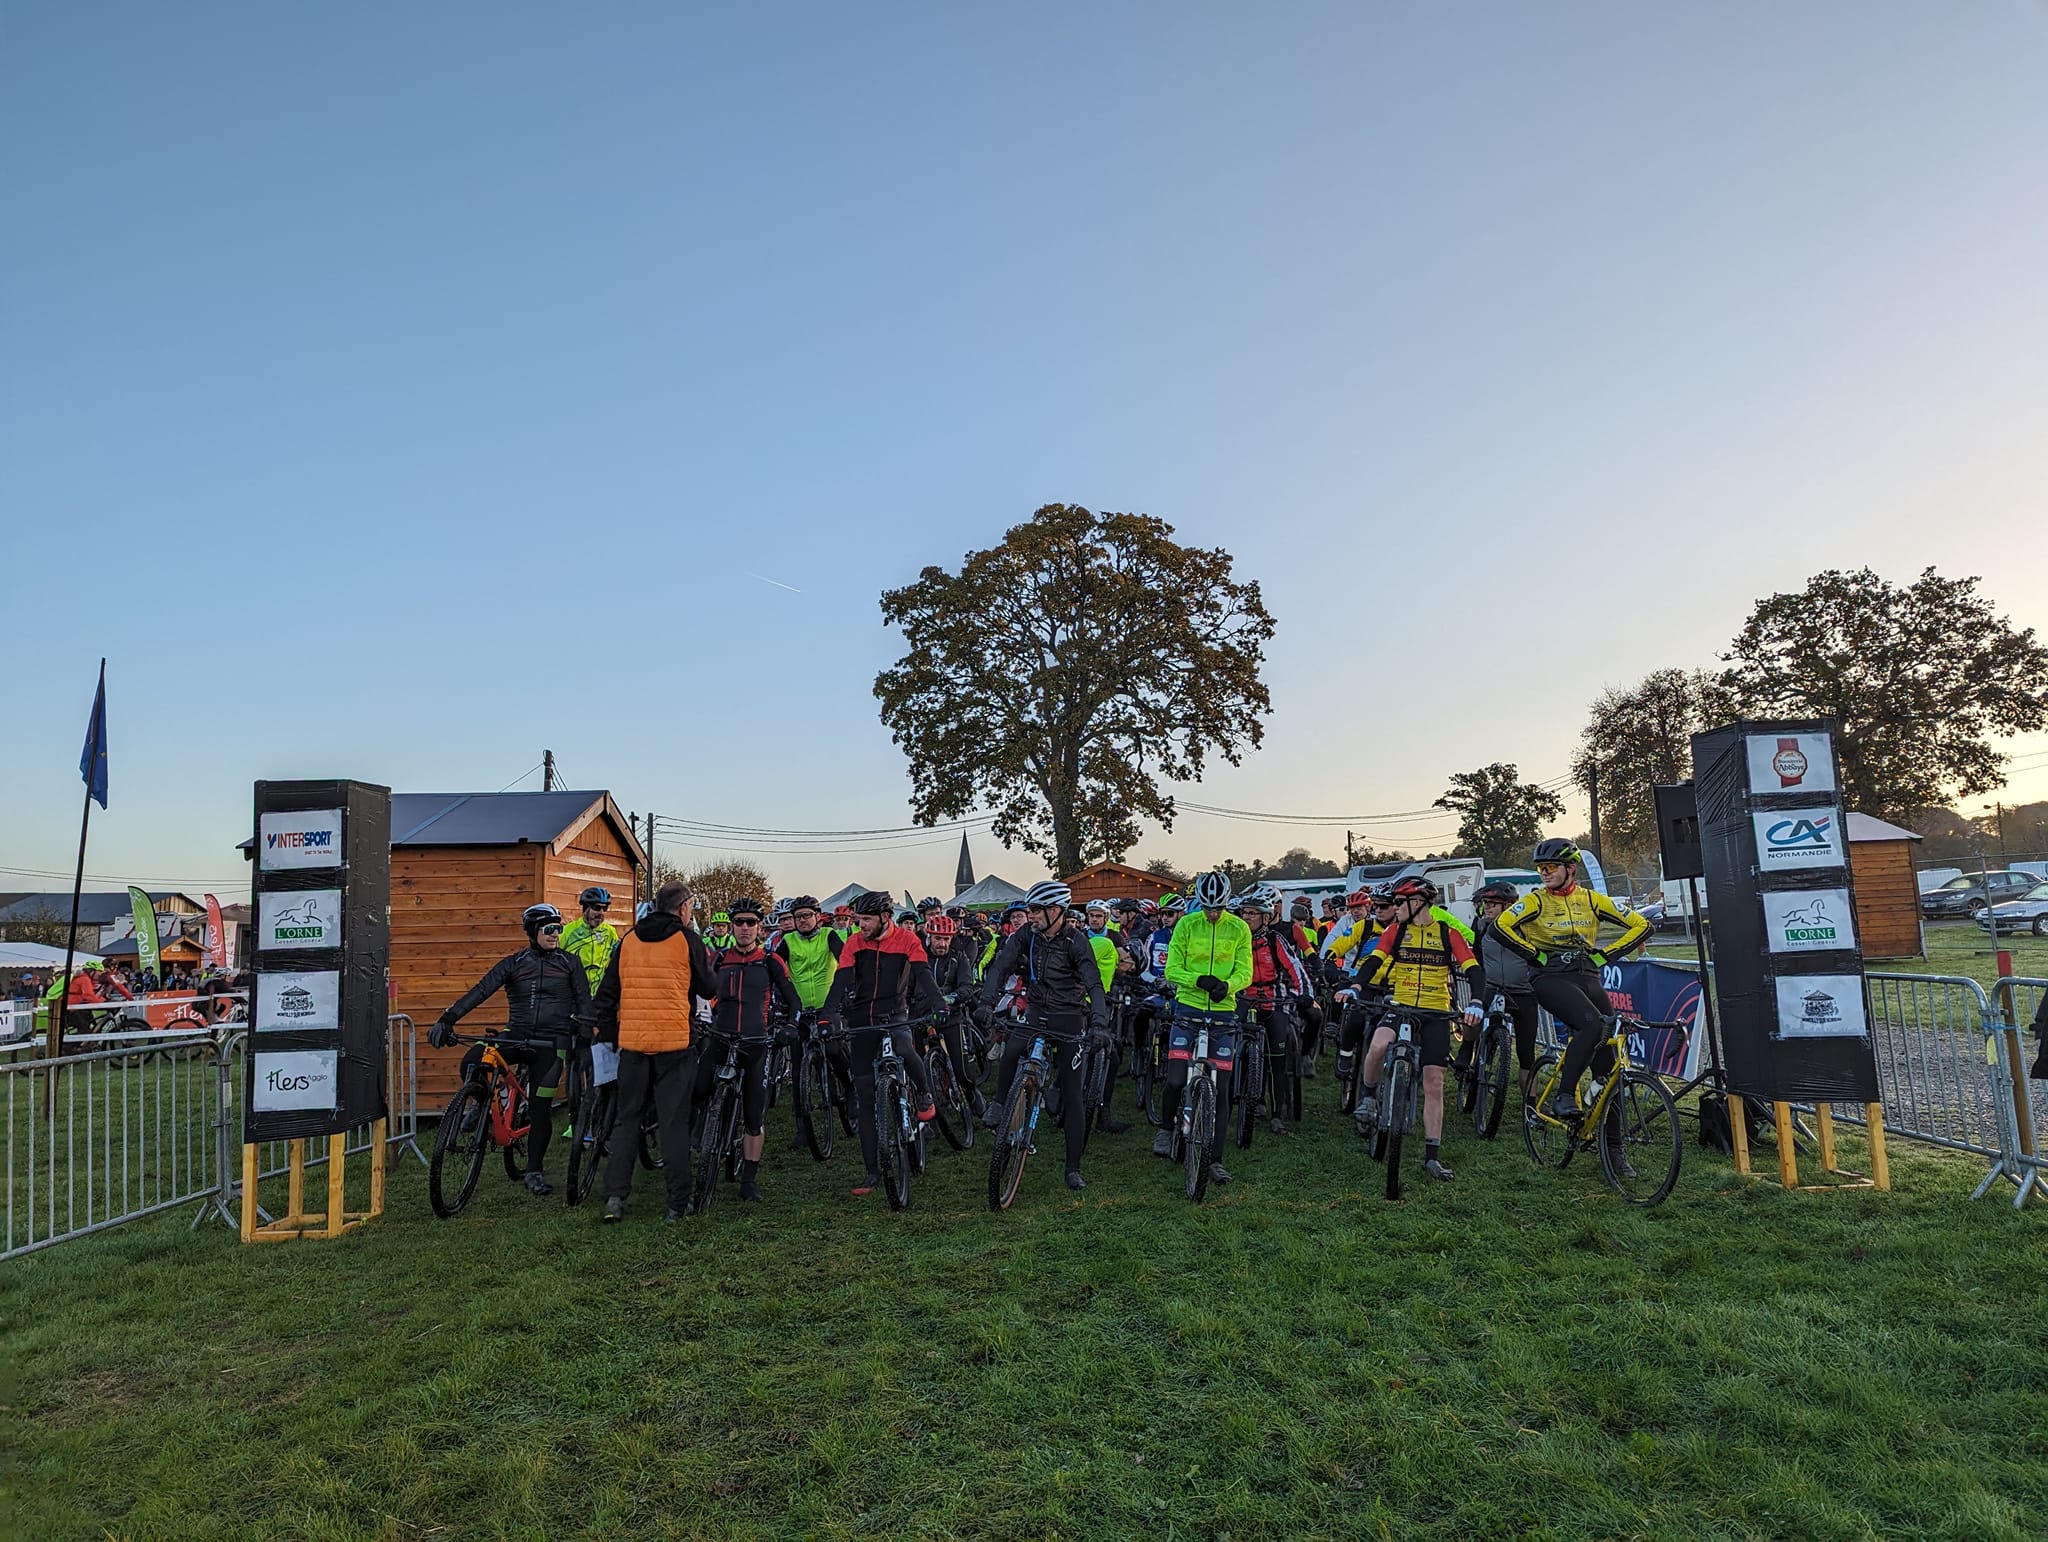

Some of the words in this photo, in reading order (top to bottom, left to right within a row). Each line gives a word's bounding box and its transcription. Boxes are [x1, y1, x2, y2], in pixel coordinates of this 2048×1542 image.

[277, 831, 333, 848] INTERSPORT
[1768, 849, 1832, 859] NORMANDIE
[277, 928, 321, 938] L'ORNE
[1787, 928, 1835, 940] L'ORNE
[1603, 965, 1622, 990] 20
[1627, 1032, 1646, 1058] 24
